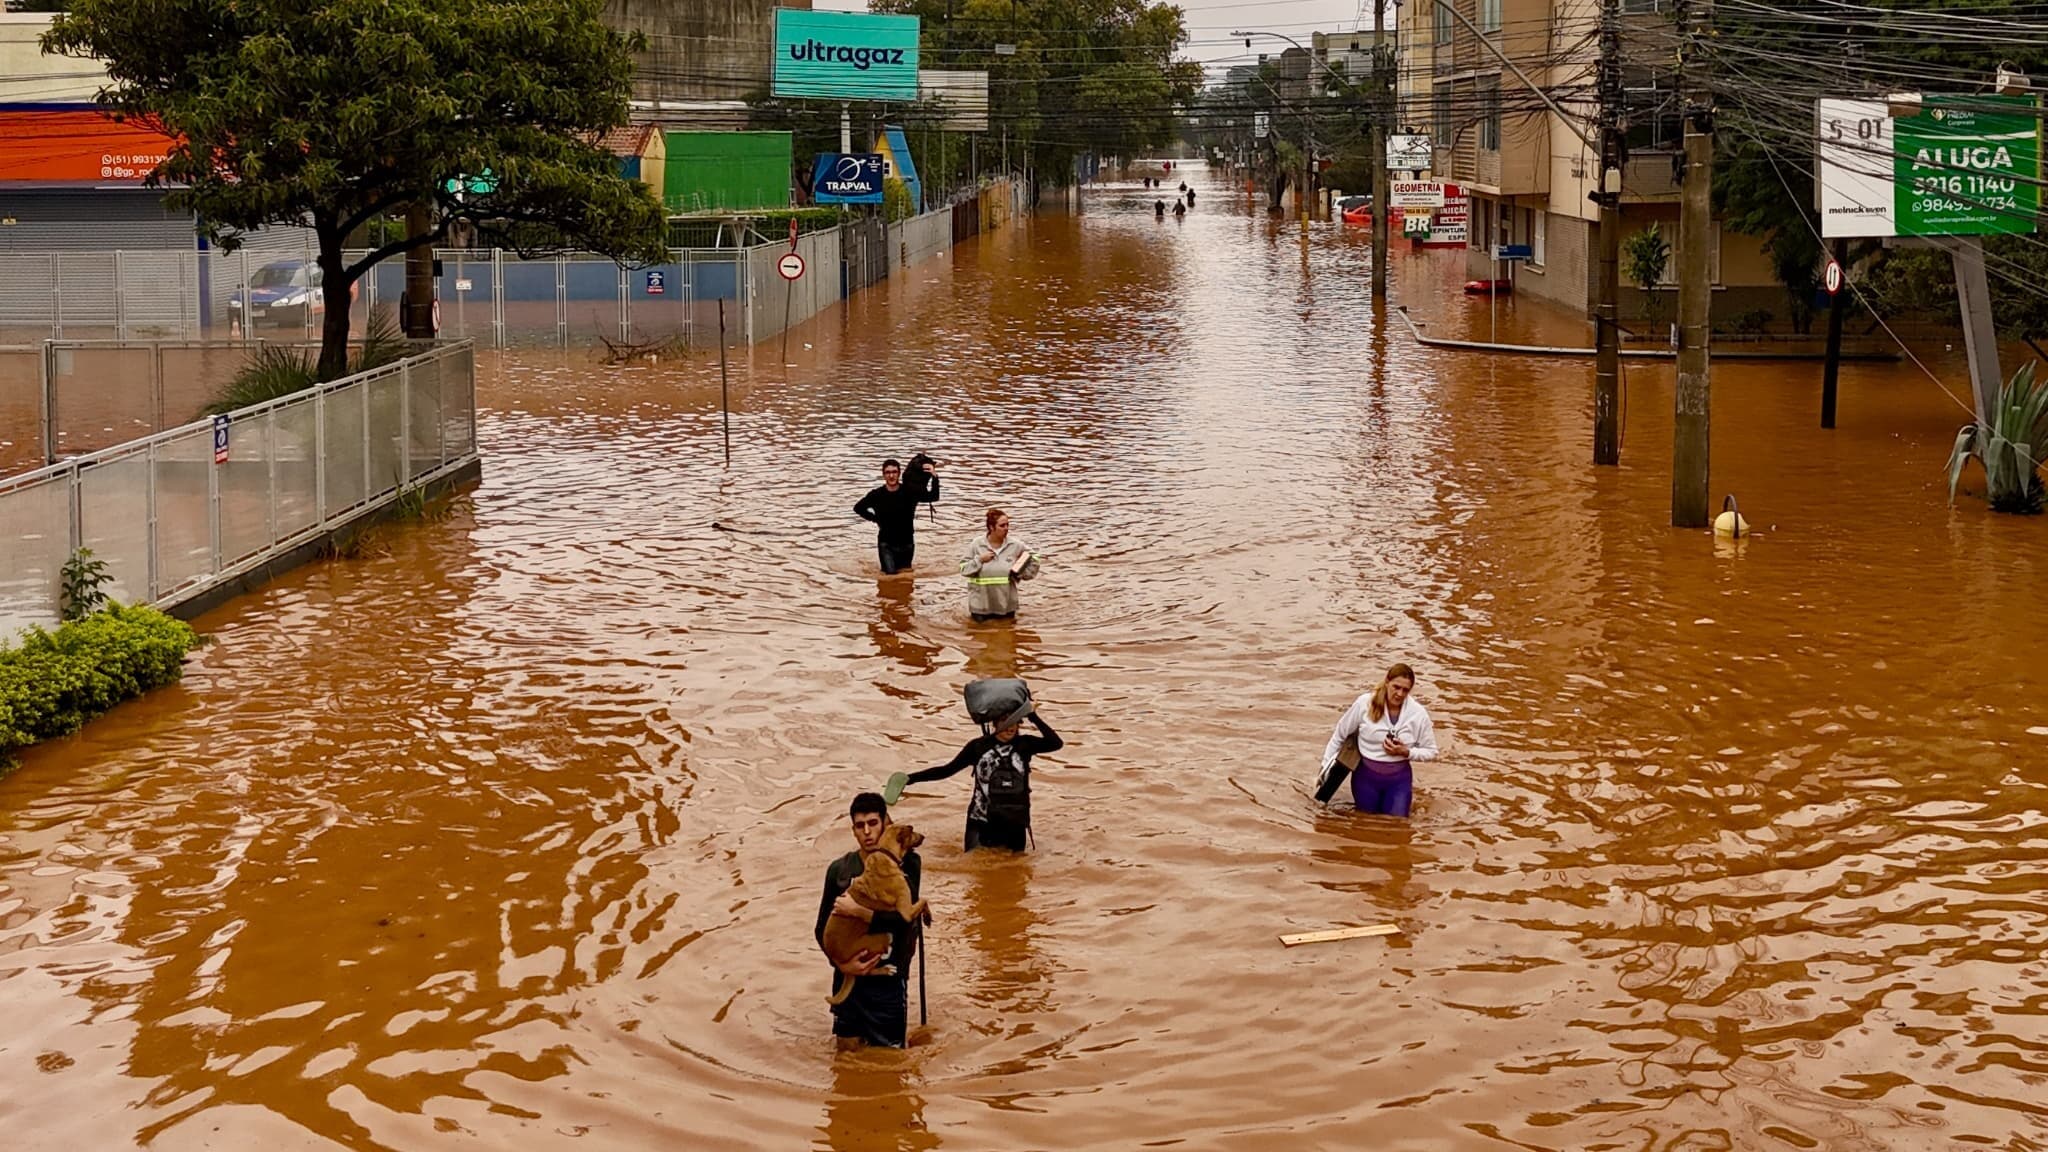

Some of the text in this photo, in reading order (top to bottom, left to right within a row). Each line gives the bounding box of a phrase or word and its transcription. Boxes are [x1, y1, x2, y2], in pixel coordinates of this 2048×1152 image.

[790, 38, 904, 71] ultragaz
[112, 155, 131, 165] (51)
[1911, 146, 2014, 171] ALUGA
[826, 181, 873, 191] TRAPVAL
[1394, 183, 1441, 193] GEOMETRIA
[1966, 175, 2016, 194] 1140
[1405, 217, 1429, 232] BR
